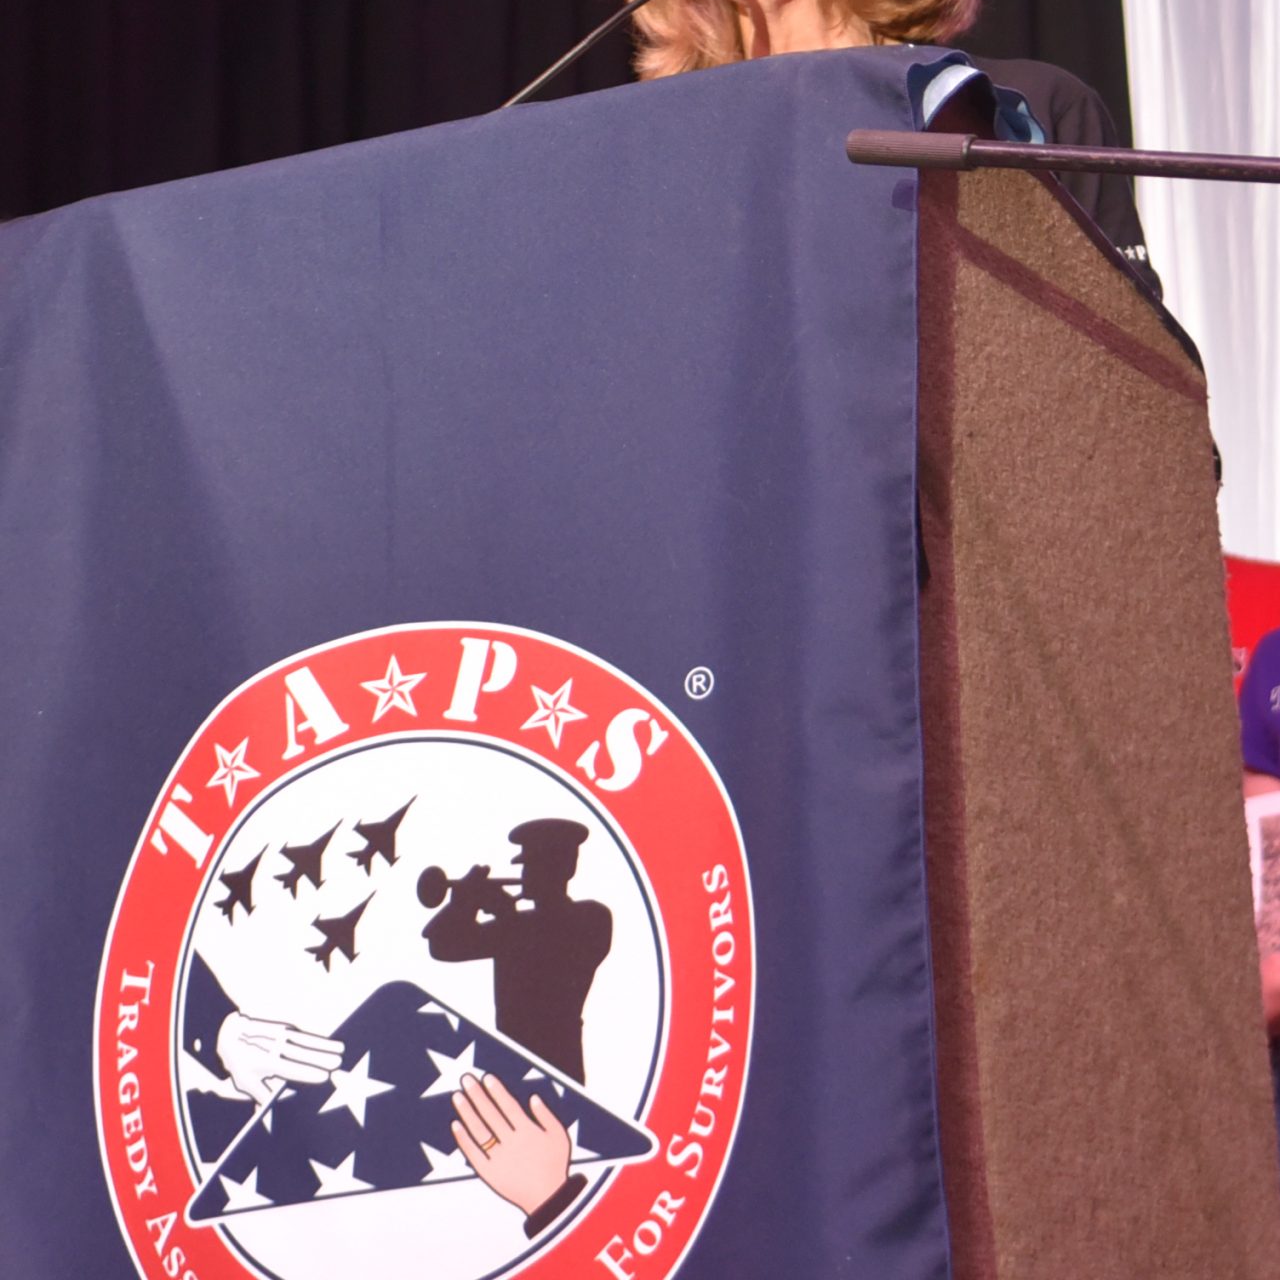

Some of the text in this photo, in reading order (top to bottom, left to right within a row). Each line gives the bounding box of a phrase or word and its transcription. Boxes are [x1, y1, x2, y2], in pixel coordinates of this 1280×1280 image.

[116, 959, 158, 1200] TRAGEDY
[594, 863, 737, 1280] FOR SURVIVORS
